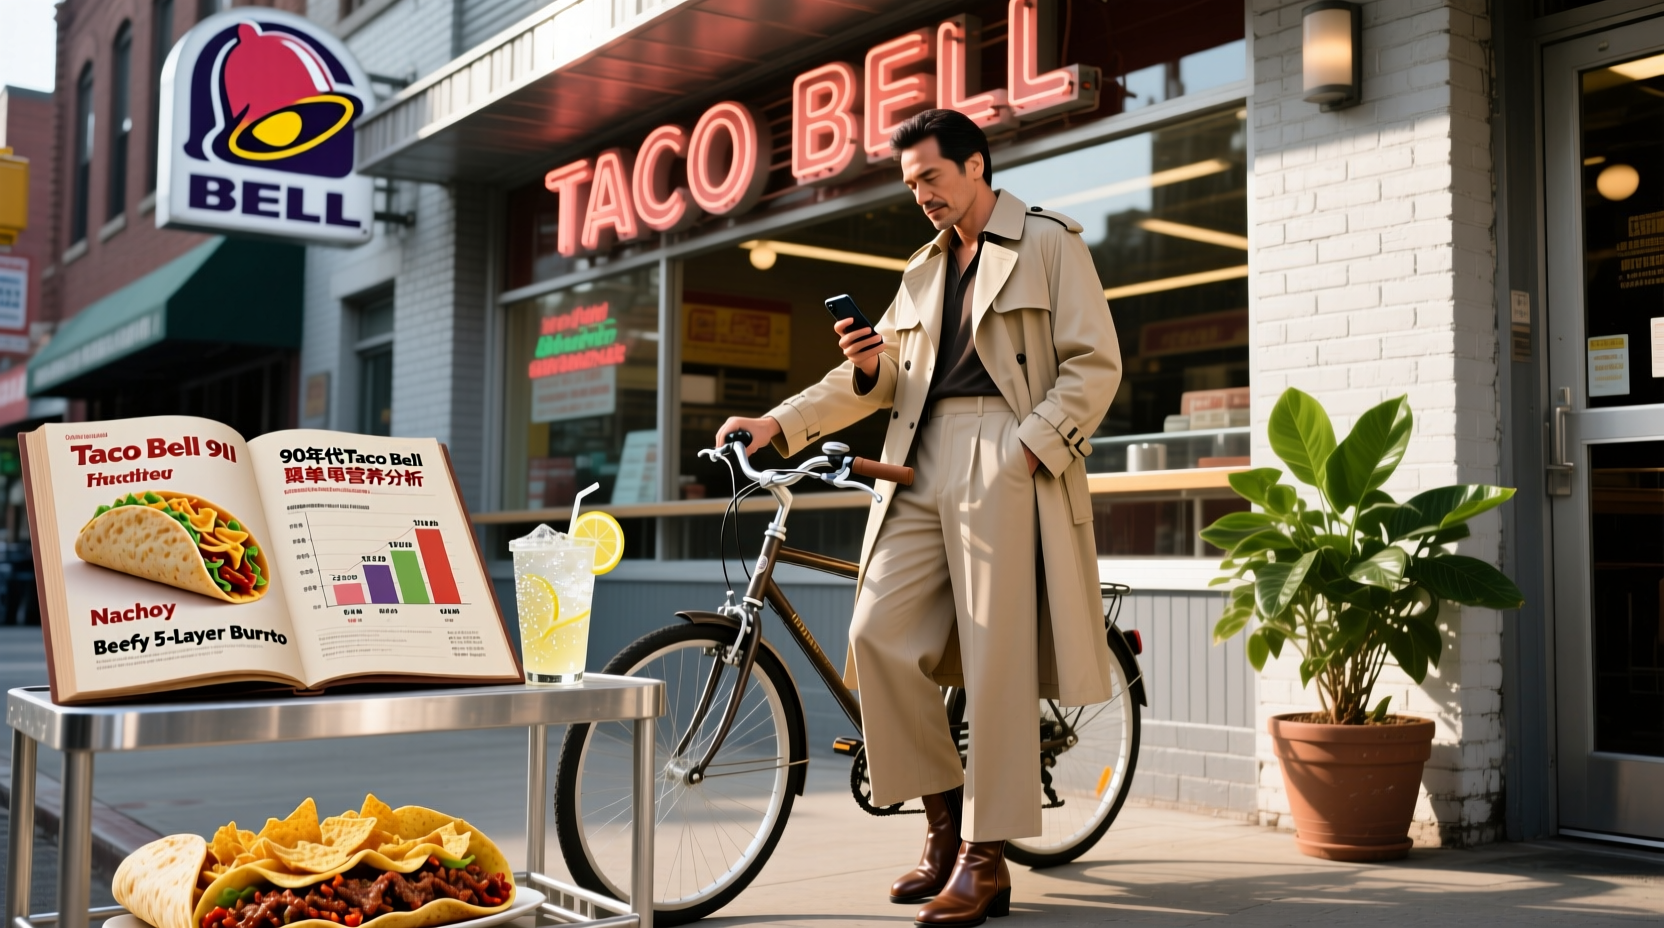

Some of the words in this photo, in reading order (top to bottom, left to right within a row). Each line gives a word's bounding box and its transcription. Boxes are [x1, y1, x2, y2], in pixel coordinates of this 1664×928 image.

[545, 101, 758, 257] TACO
[792, 0, 1079, 186] BELL
[189, 173, 361, 228] BELL
[70, 444, 141, 466] Taco
[146, 436, 200, 458] Bell
[389, 452, 424, 467] Bell
[90, 602, 176, 626] Nachoy
[94, 633, 150, 656] Beefy
[154, 628, 226, 647] 5-Layer
